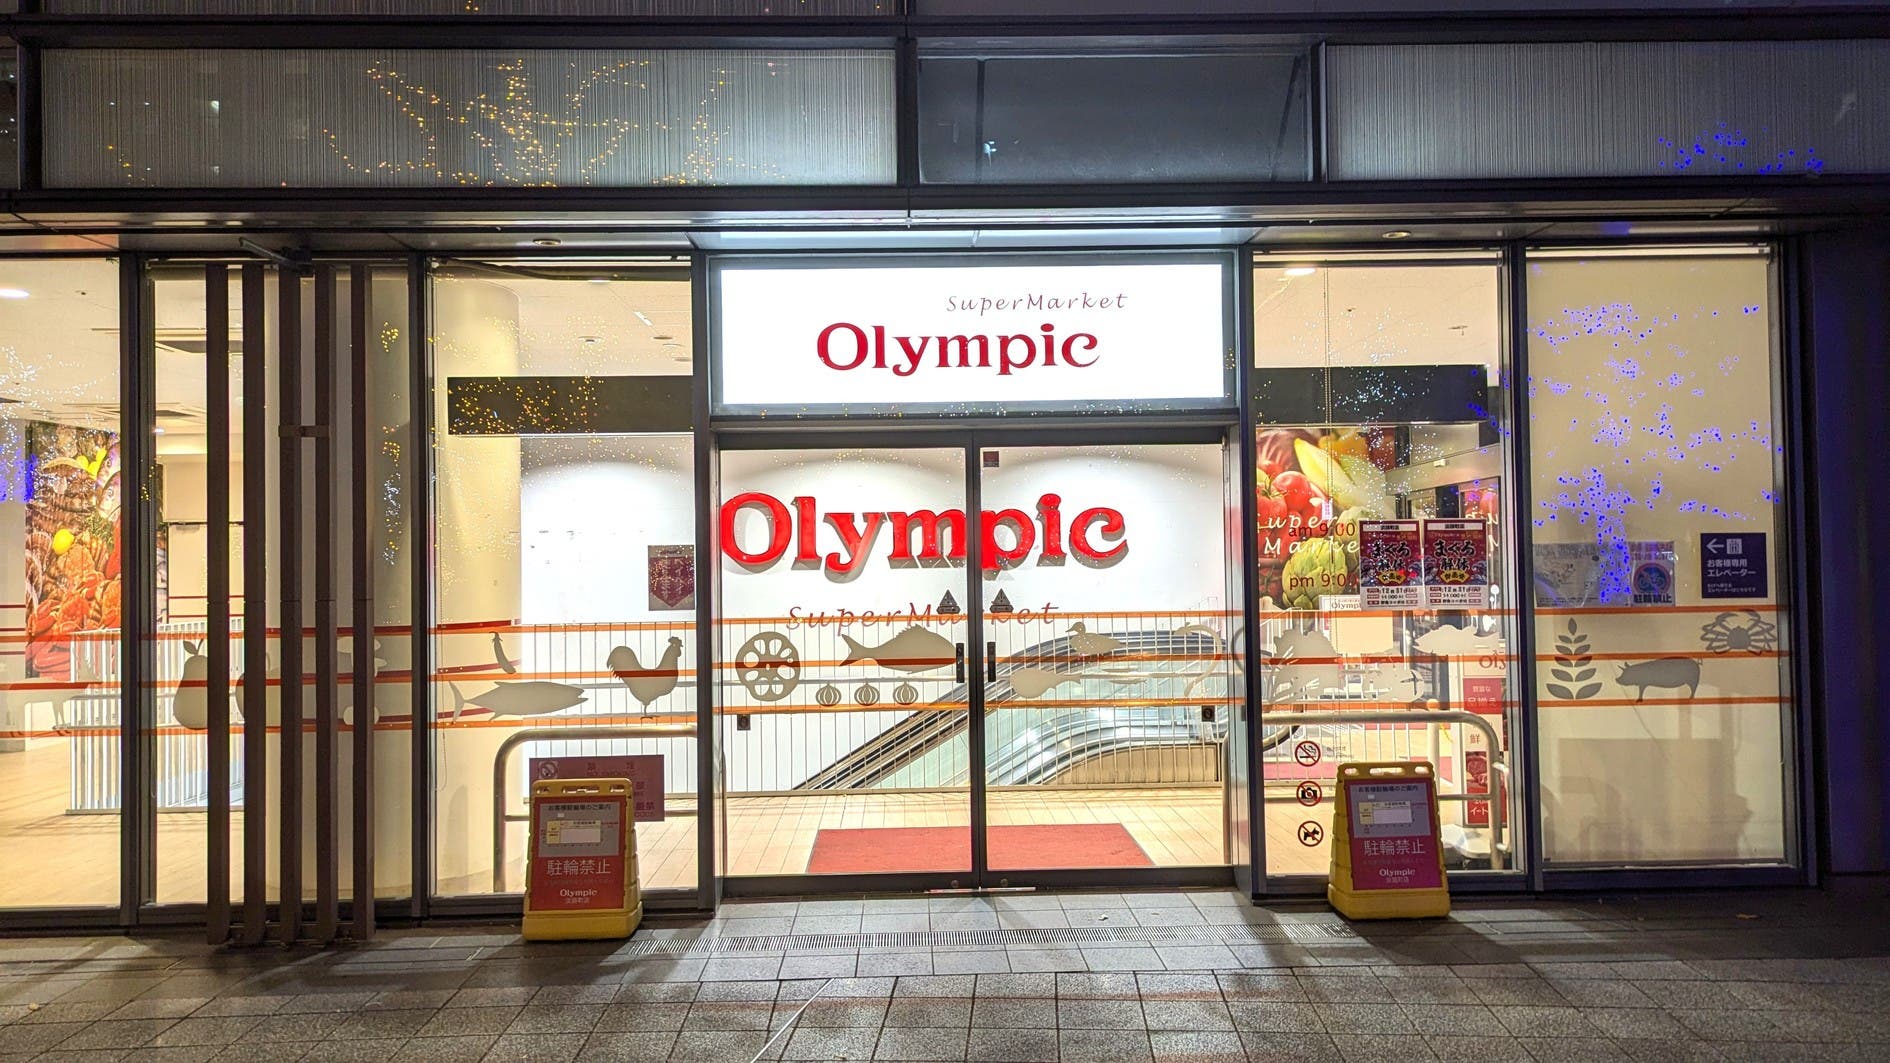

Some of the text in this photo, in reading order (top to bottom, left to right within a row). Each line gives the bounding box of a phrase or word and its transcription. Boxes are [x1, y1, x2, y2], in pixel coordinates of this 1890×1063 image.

[946, 291, 1128, 317] SuperMarket
[816, 321, 1099, 377] Olympic
[1257, 512, 1338, 530] uper
[720, 491, 1126, 579] Olympic
[1288, 526, 1313, 537] am
[1263, 536, 1360, 555] Marke
[1371, 540, 1412, 558] まぐろ
[1433, 539, 1477, 558] まぐろ
[1439, 556, 1471, 571] 解体
[1706, 558, 1748, 568] お客様専用
[1289, 573, 1358, 590] pm 9:00
[1706, 568, 1757, 577] エレベーター
[787, 601, 1059, 636] SuperMaket
[1363, 837, 1427, 857] 駐輪禁止
[546, 859, 612, 876] 駐輪禁止
[1378, 868, 1416, 878] Olympic
[559, 887, 597, 898] Olympic
